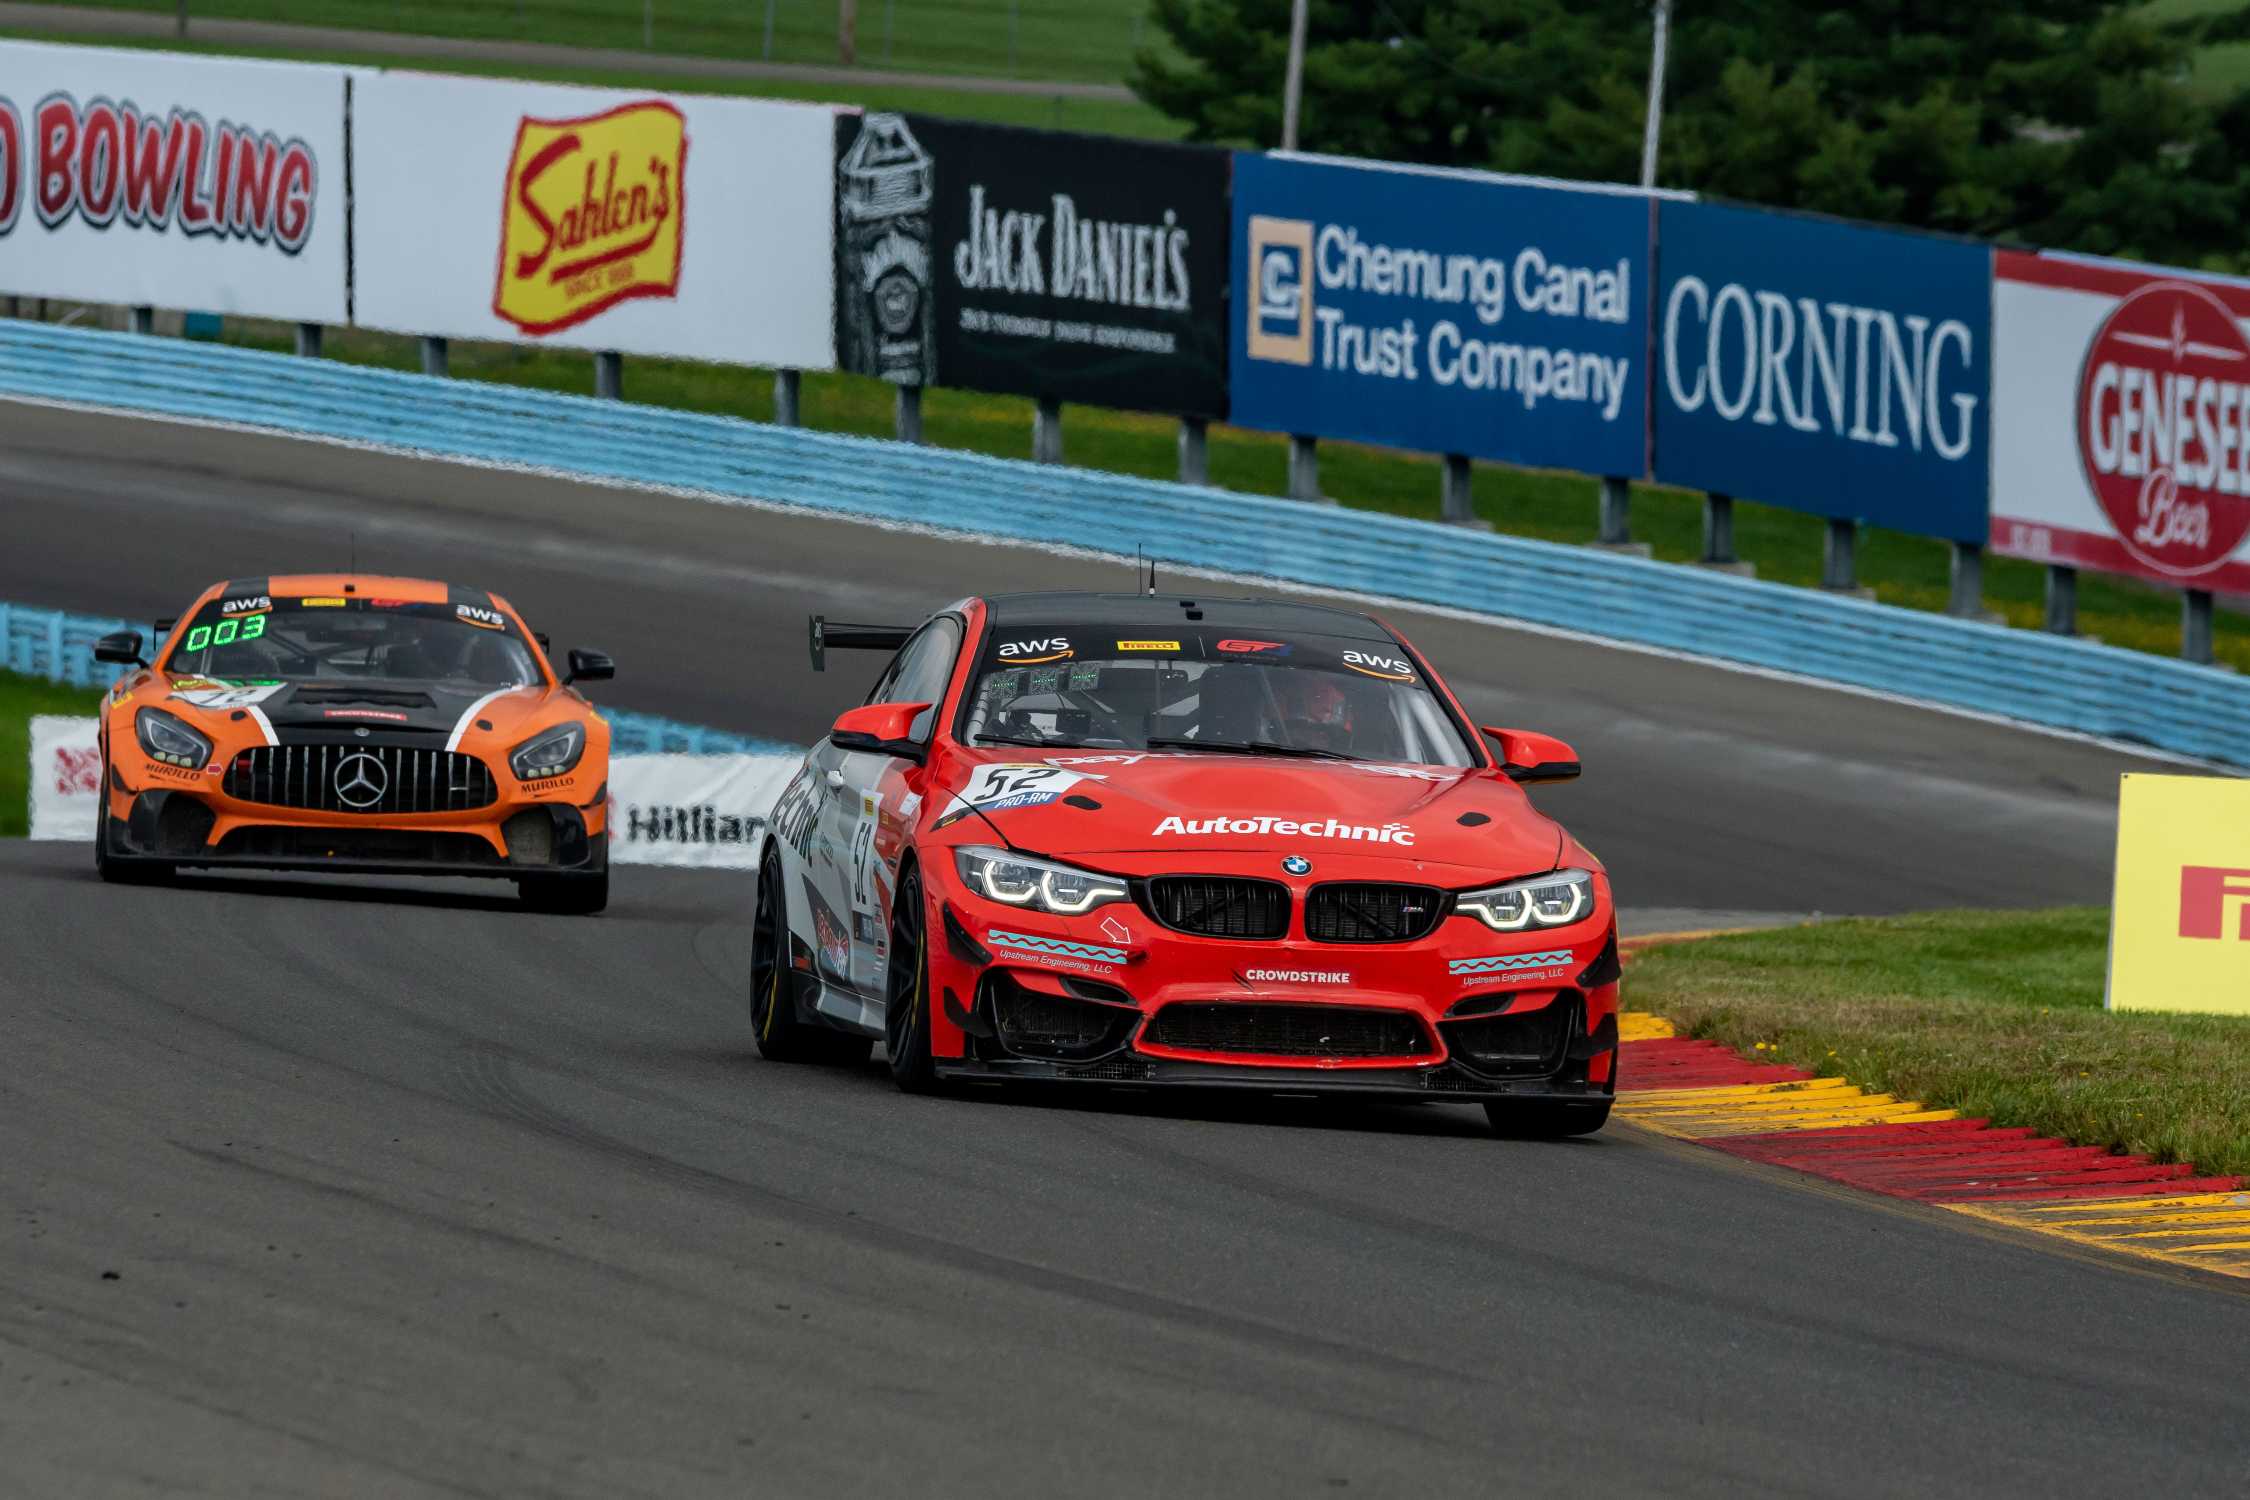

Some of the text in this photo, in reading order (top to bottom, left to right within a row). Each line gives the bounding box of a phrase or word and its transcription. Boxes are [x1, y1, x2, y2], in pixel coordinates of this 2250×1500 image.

[34, 92, 317, 252] BOWLING
[514, 131, 671, 280] Sahlen's
[953, 184, 1046, 295] JACK
[1050, 193, 1192, 313] DANIEL'S
[1315, 223, 1631, 325] Chemung Canal
[1315, 306, 1631, 421] Trust Company
[1663, 274, 1979, 461] CORNING
[222, 595, 271, 613] aws
[456, 604, 505, 625] aws
[185, 613, 266, 652] 003
[999, 636, 1070, 657] aws
[1343, 650, 1412, 674] aws
[520, 777, 575, 793] MURILLO
[973, 768, 1062, 802] 52
[994, 791, 1053, 809] PRO-AM
[627, 803, 767, 843] Hilliar
[1151, 816, 1416, 846] AutoTechnic
[999, 949, 1039, 963] Upstream
[1094, 964, 1113, 974] LLC
[1245, 969, 1351, 984] CROWDSTRIKE
[1463, 975, 1500, 986] Upstream
[1548, 967, 1565, 978] LLC
